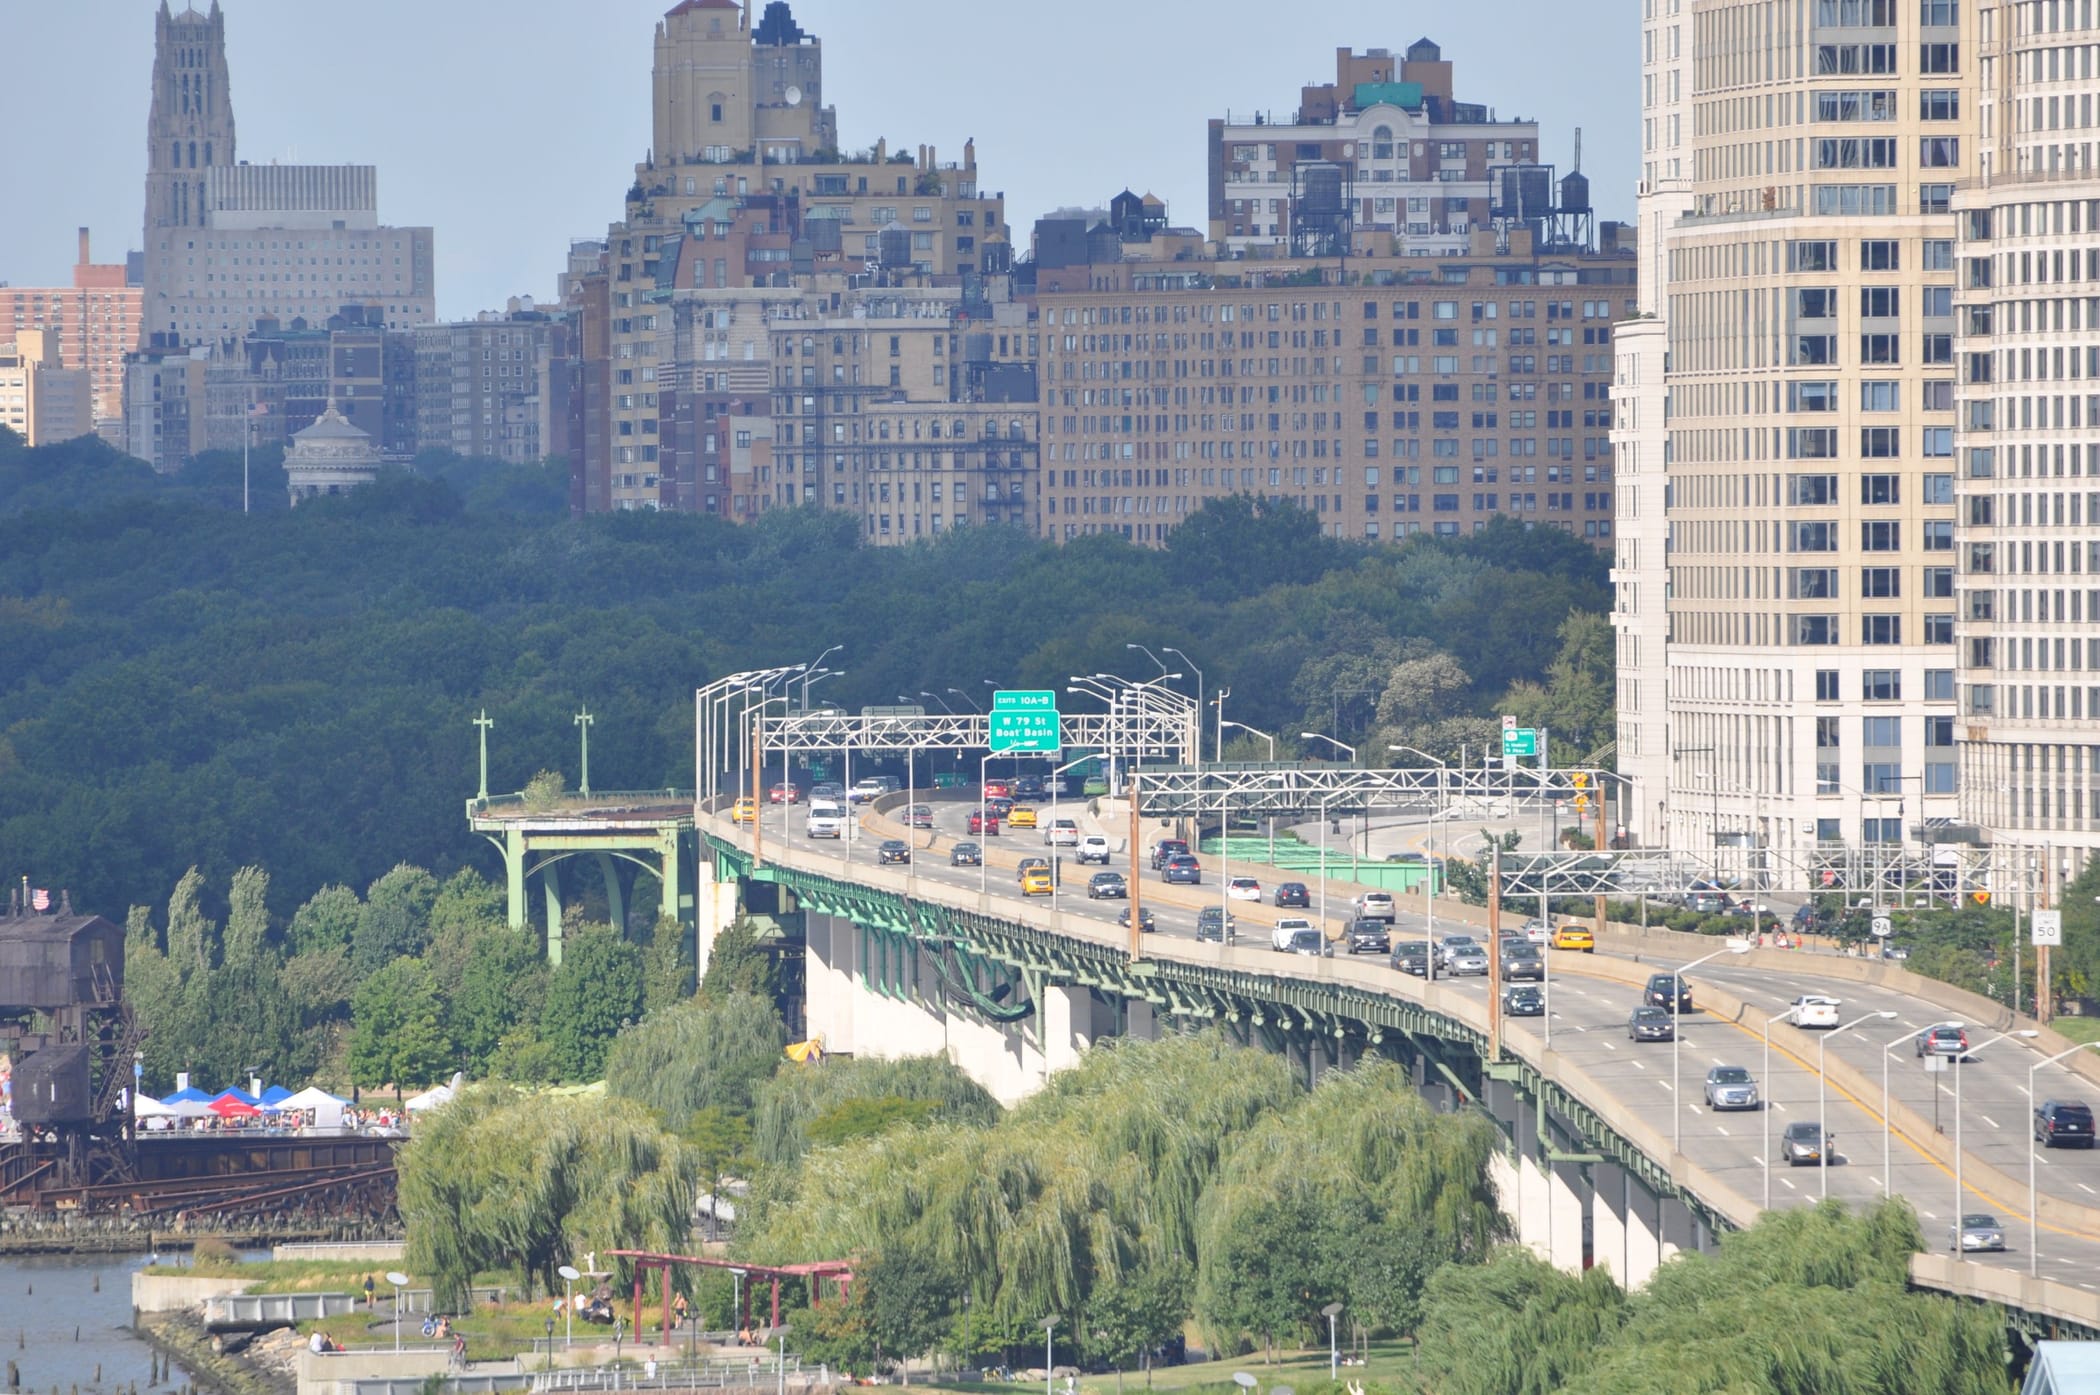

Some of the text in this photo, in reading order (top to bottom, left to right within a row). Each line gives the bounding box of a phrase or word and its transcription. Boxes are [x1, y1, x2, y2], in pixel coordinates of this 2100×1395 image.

[1021, 696, 1049, 704] 10A-B
[1002, 716, 1046, 726] W 79 St
[996, 728, 1053, 737] Boat Basin
[1873, 921, 1889, 932] 9A
[2038, 926, 2055, 937] 50
